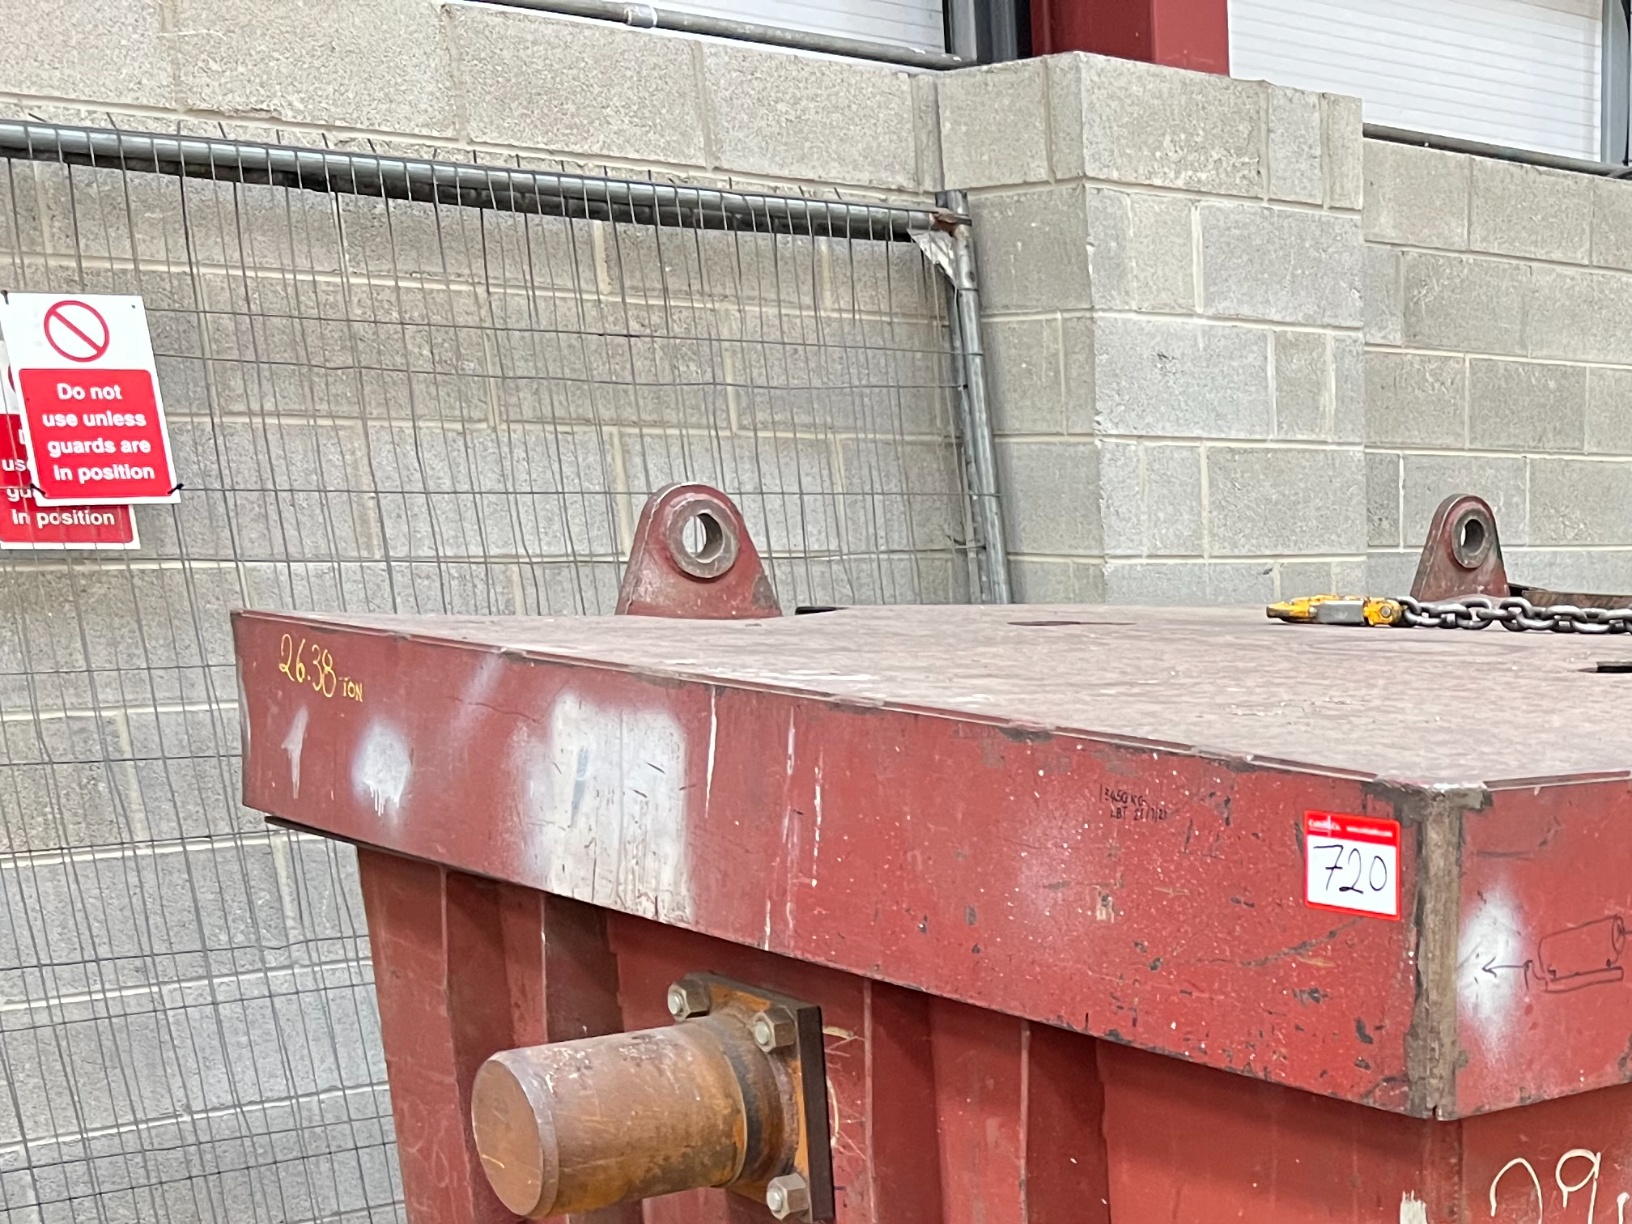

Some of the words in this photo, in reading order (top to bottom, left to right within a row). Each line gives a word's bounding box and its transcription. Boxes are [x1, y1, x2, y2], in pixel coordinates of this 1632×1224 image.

[57, 382, 86, 400] Do
[90, 384, 123, 400] not
[42, 413, 78, 427] use
[83, 410, 147, 427] unless
[47, 437, 117, 458] guards
[120, 440, 152, 454] are
[77, 463, 155, 485] position
[36, 507, 115, 529] position
[279, 633, 337, 698] 26.38
[1312, 844, 1388, 895] 720
